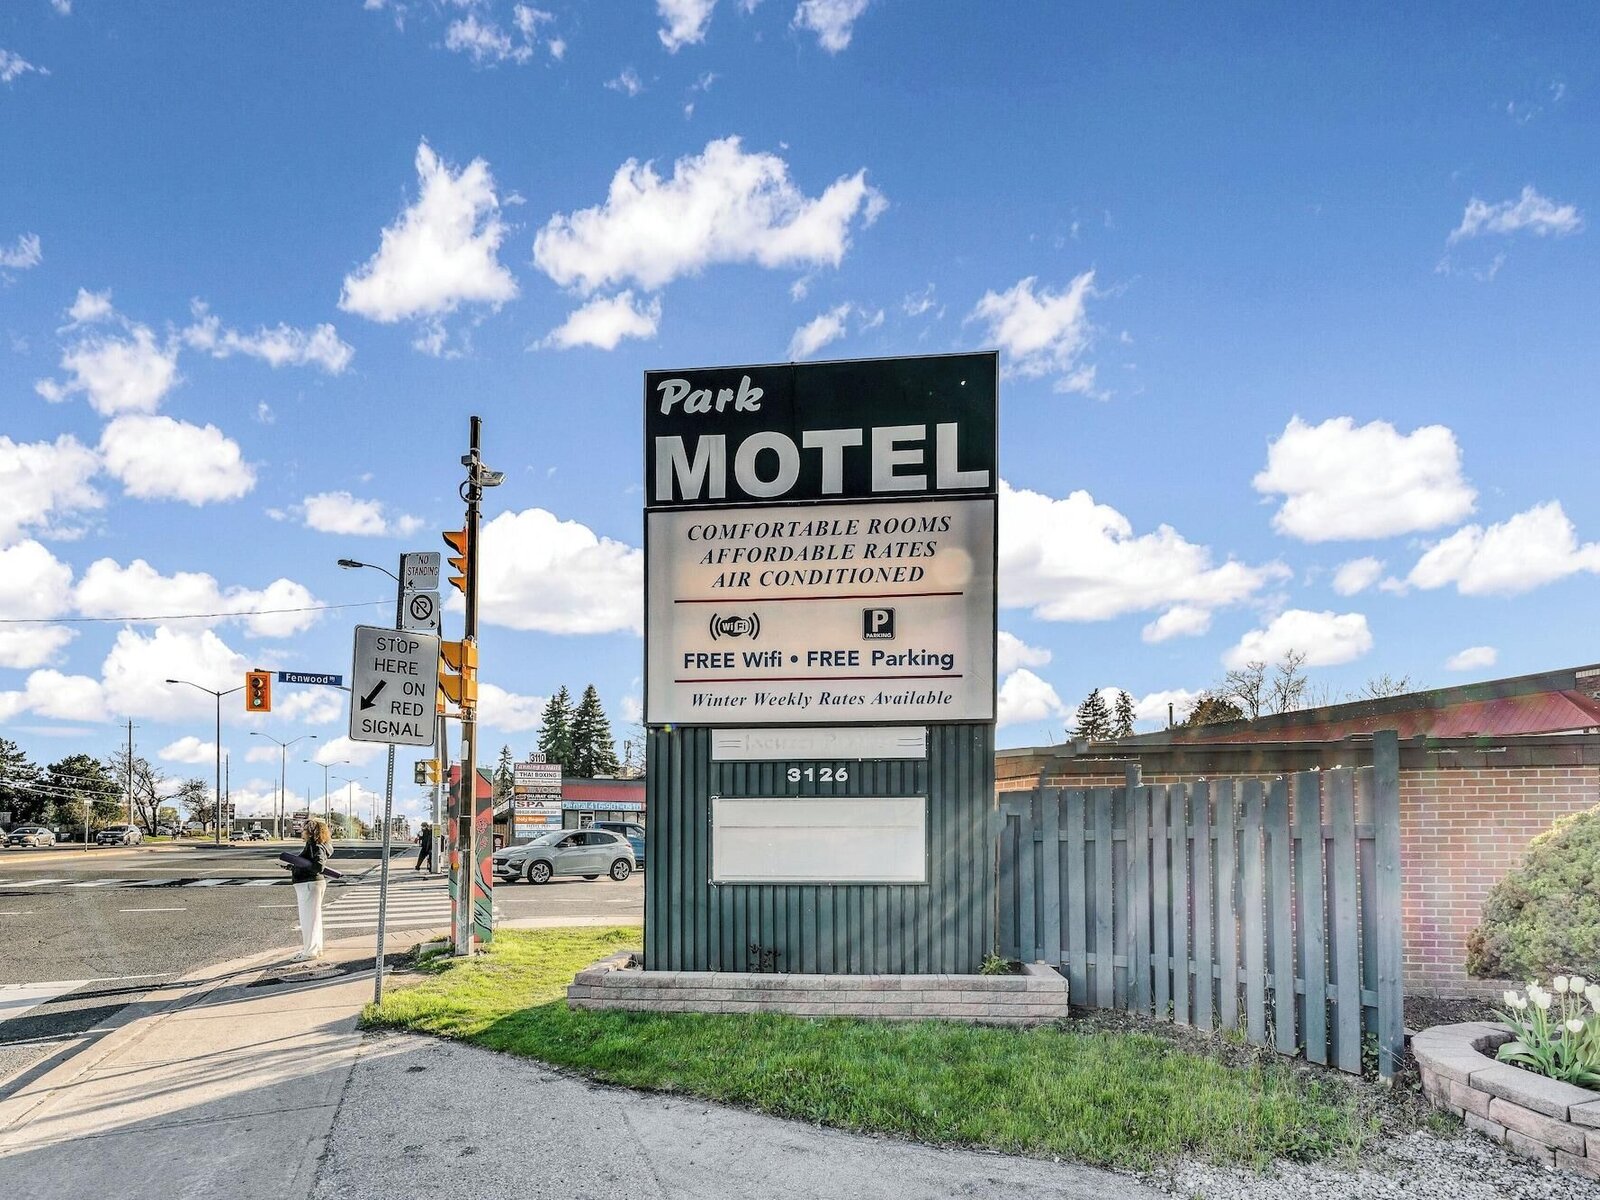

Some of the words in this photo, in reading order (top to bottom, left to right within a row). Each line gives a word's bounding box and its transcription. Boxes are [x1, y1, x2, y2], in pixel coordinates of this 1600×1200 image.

[656, 375, 764, 415] Park
[655, 421, 990, 502] MOTEL
[687, 519, 860, 541] COMFORTABLE
[868, 515, 952, 535] ROOMS
[417, 555, 430, 564] NO
[700, 545, 856, 565] AFFORDABLE
[863, 540, 938, 559] RATES
[407, 566, 439, 576] STANDING
[711, 571, 752, 588] AIR
[759, 565, 925, 587] CONDITIONED
[376, 637, 420, 655] STOP
[374, 657, 419, 676] HERE
[684, 652, 735, 669] FREE
[742, 651, 782, 668] Wifi
[807, 650, 860, 667] FREE
[871, 649, 954, 670] Parking
[285, 673, 328, 684] Fenwood
[403, 681, 426, 697] ON
[692, 693, 747, 707] Winter
[754, 691, 812, 709] Weekly
[818, 690, 865, 706] Rates
[870, 688, 953, 705] Available
[391, 701, 424, 717] RED
[361, 719, 424, 737] SIGNAL
[531, 753, 545, 762] 3110
[787, 767, 849, 782] 3126
